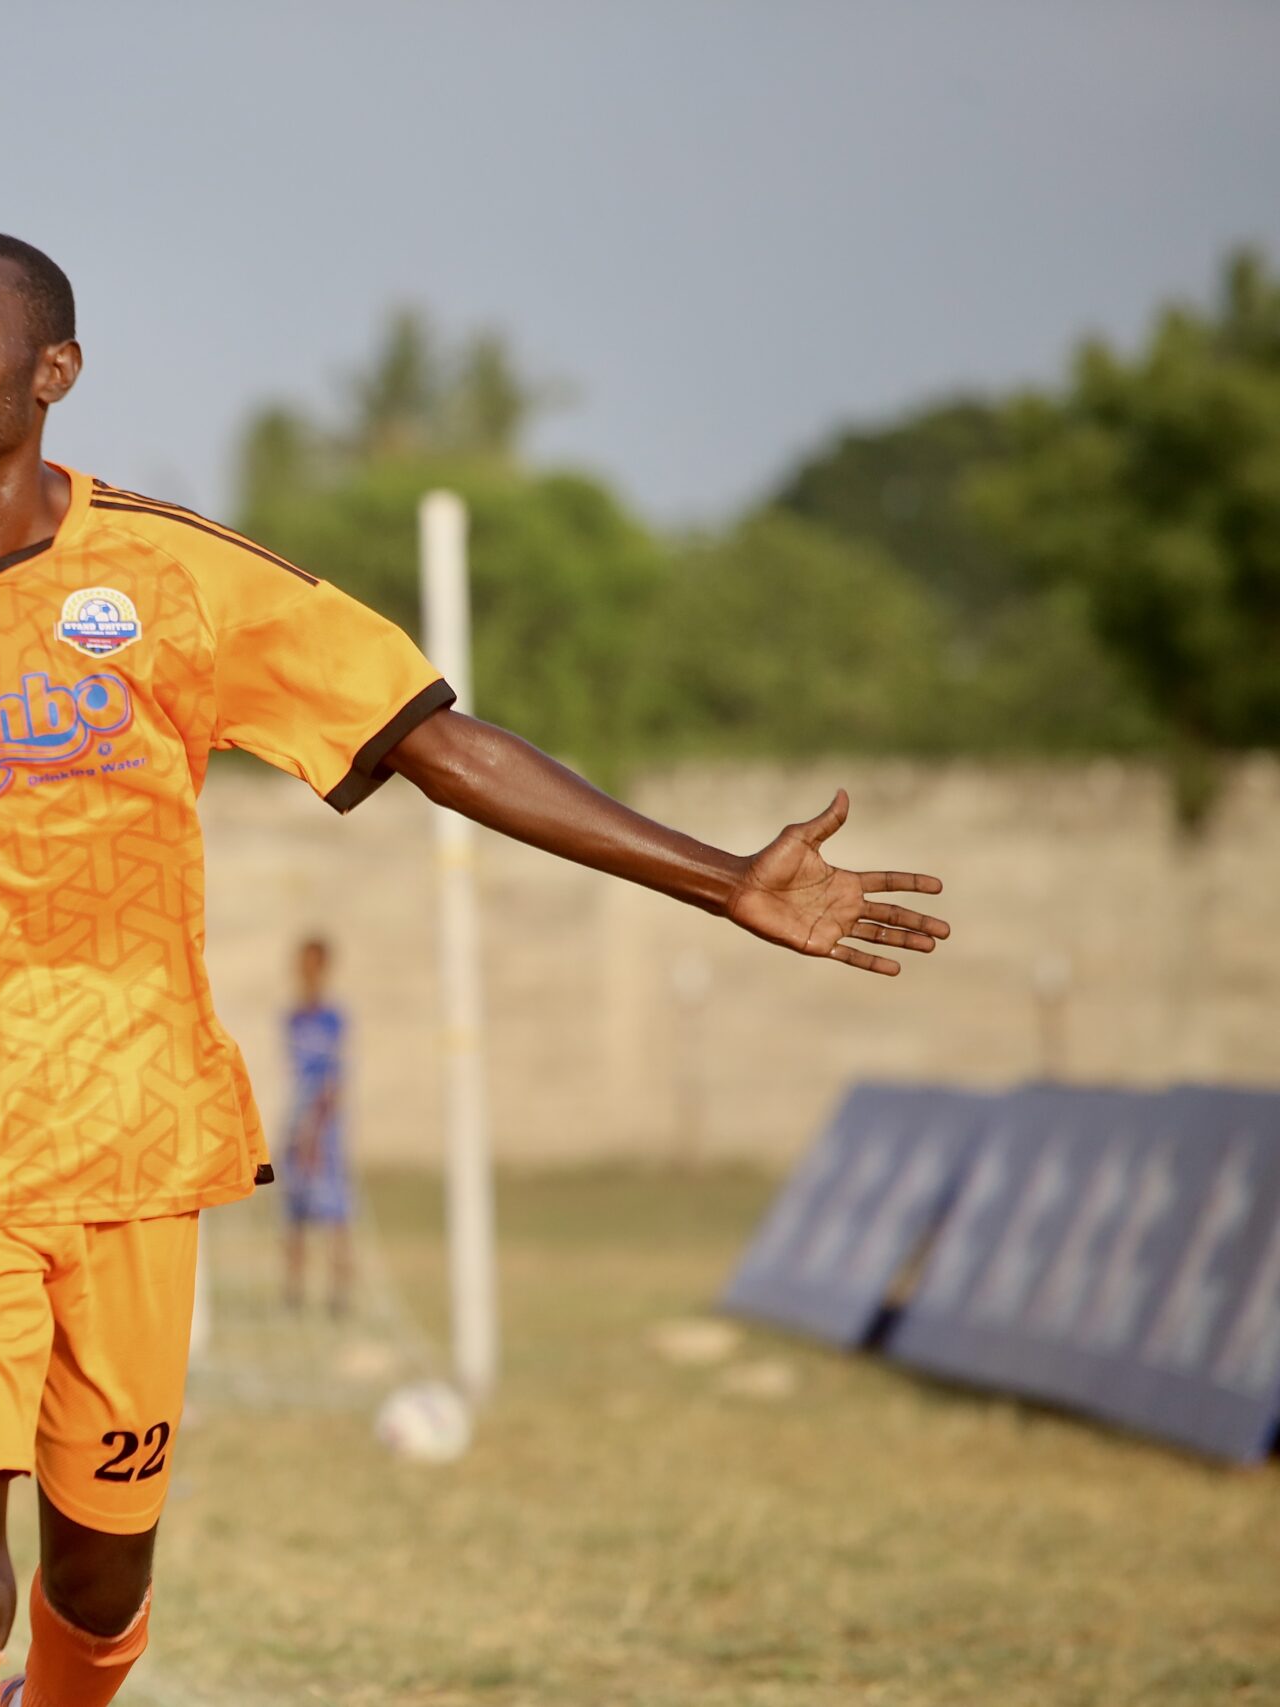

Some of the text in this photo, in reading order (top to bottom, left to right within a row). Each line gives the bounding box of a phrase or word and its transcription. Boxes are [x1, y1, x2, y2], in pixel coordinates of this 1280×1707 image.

[28, 757, 145, 787] Drinking Water
[94, 1421, 170, 1483] 22
